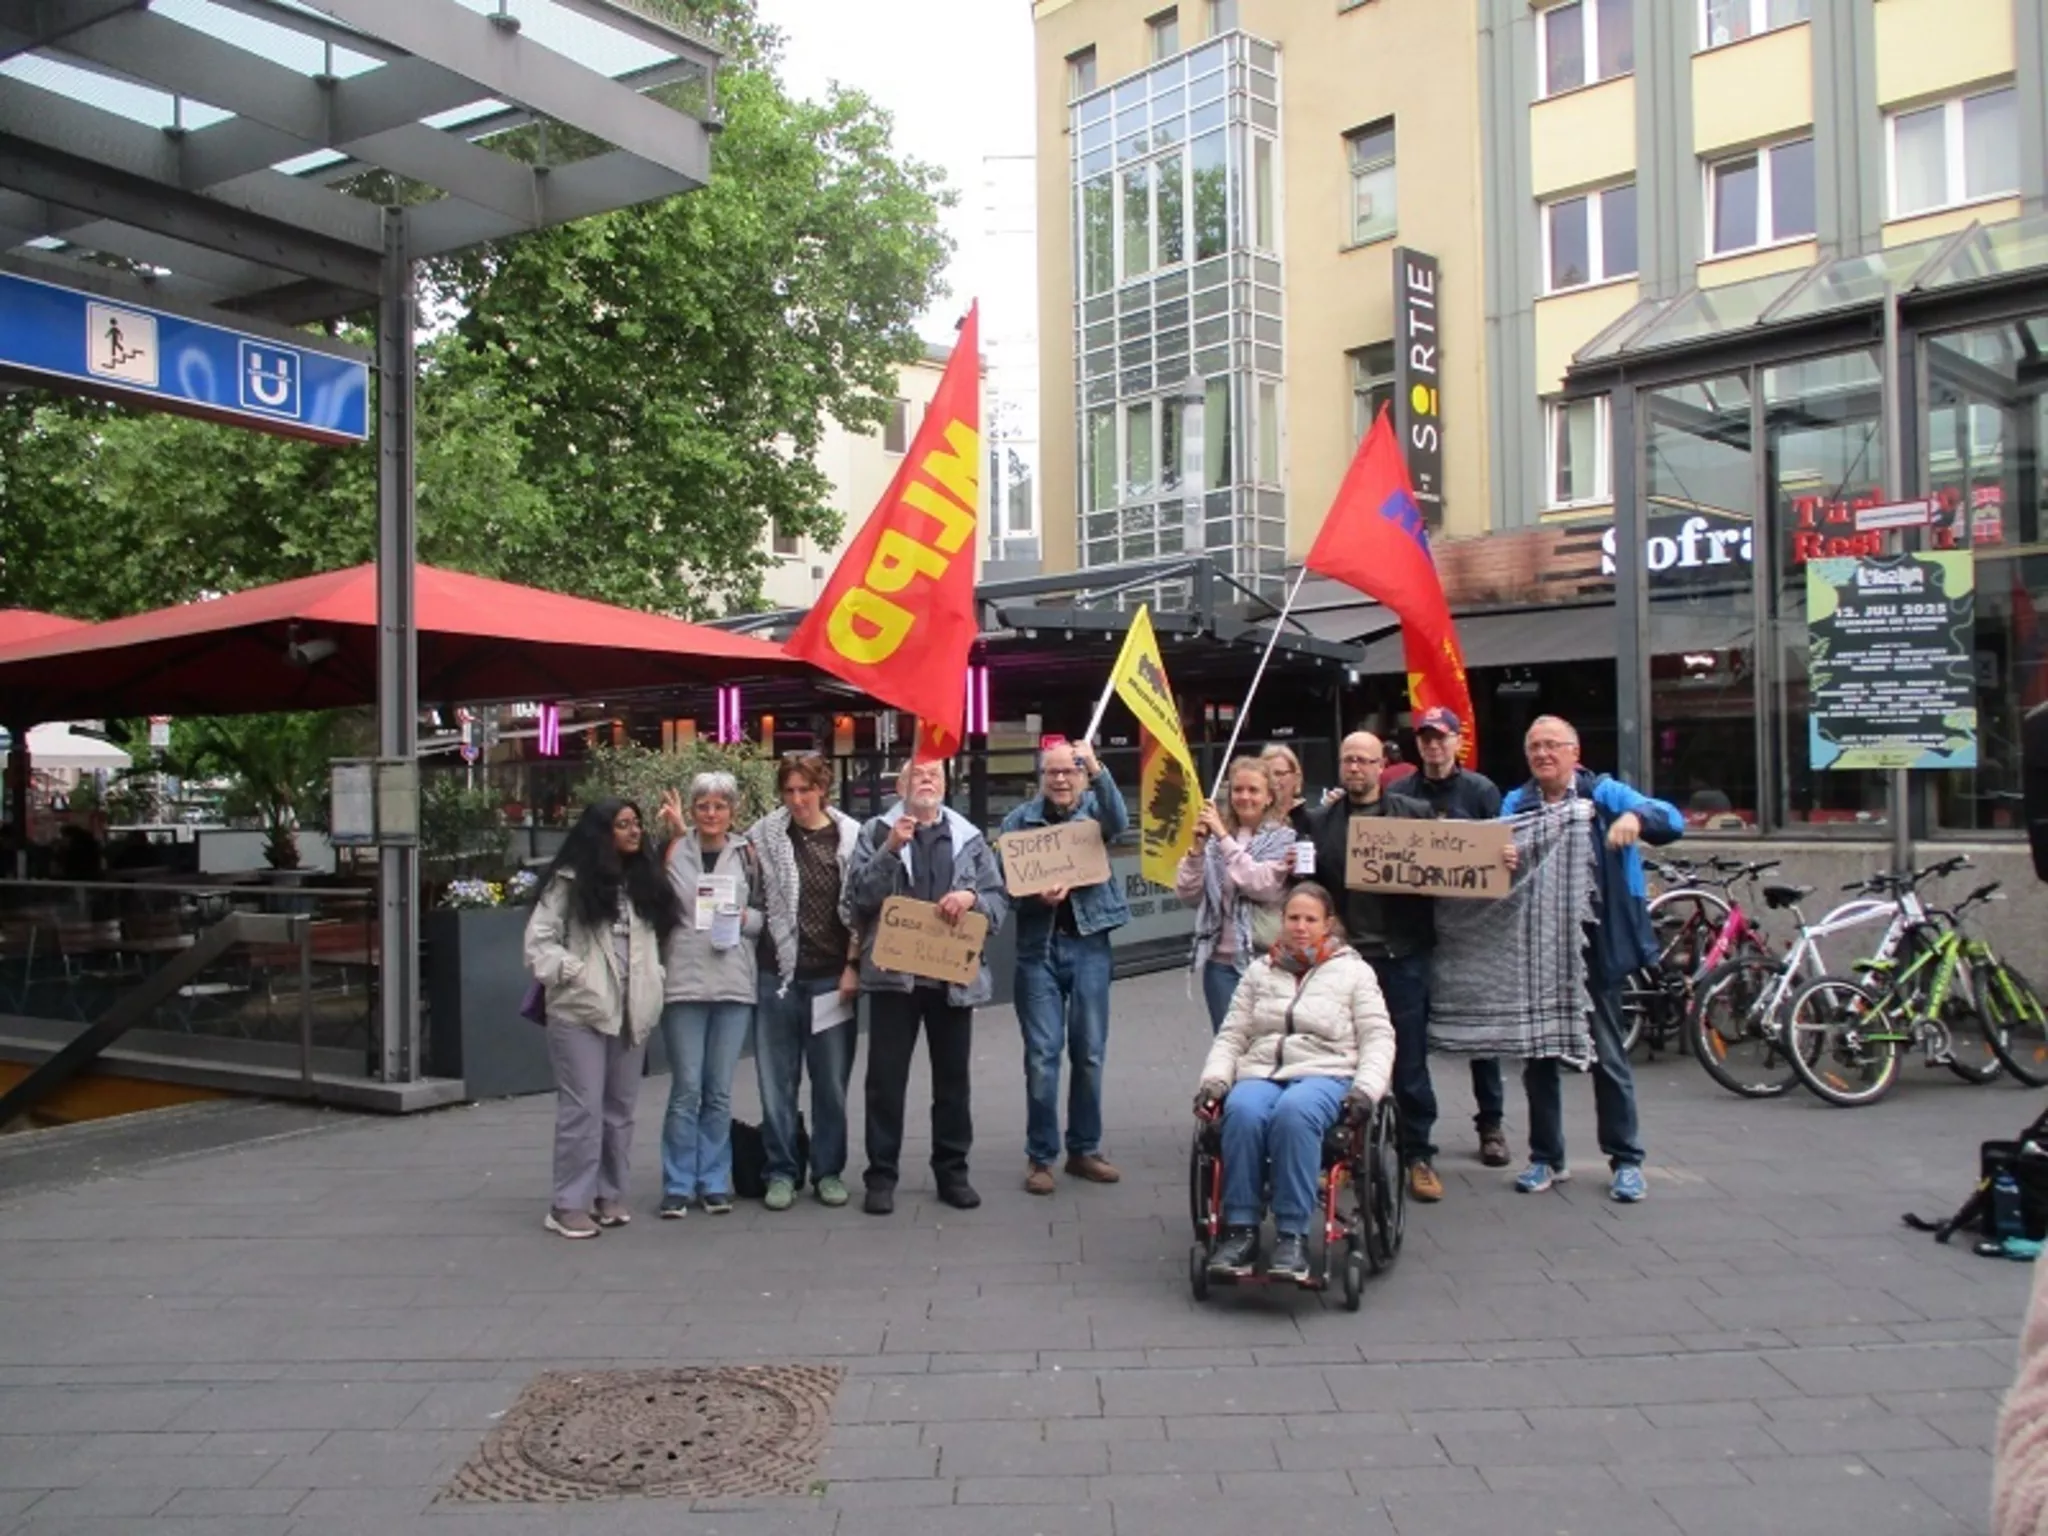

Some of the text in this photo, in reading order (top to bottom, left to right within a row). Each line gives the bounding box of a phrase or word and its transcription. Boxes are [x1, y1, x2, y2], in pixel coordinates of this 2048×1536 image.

[1407, 262, 1437, 453] SORTIE
[1864, 604, 1897, 617] JULI
[1901, 603, 1947, 616] 2025
